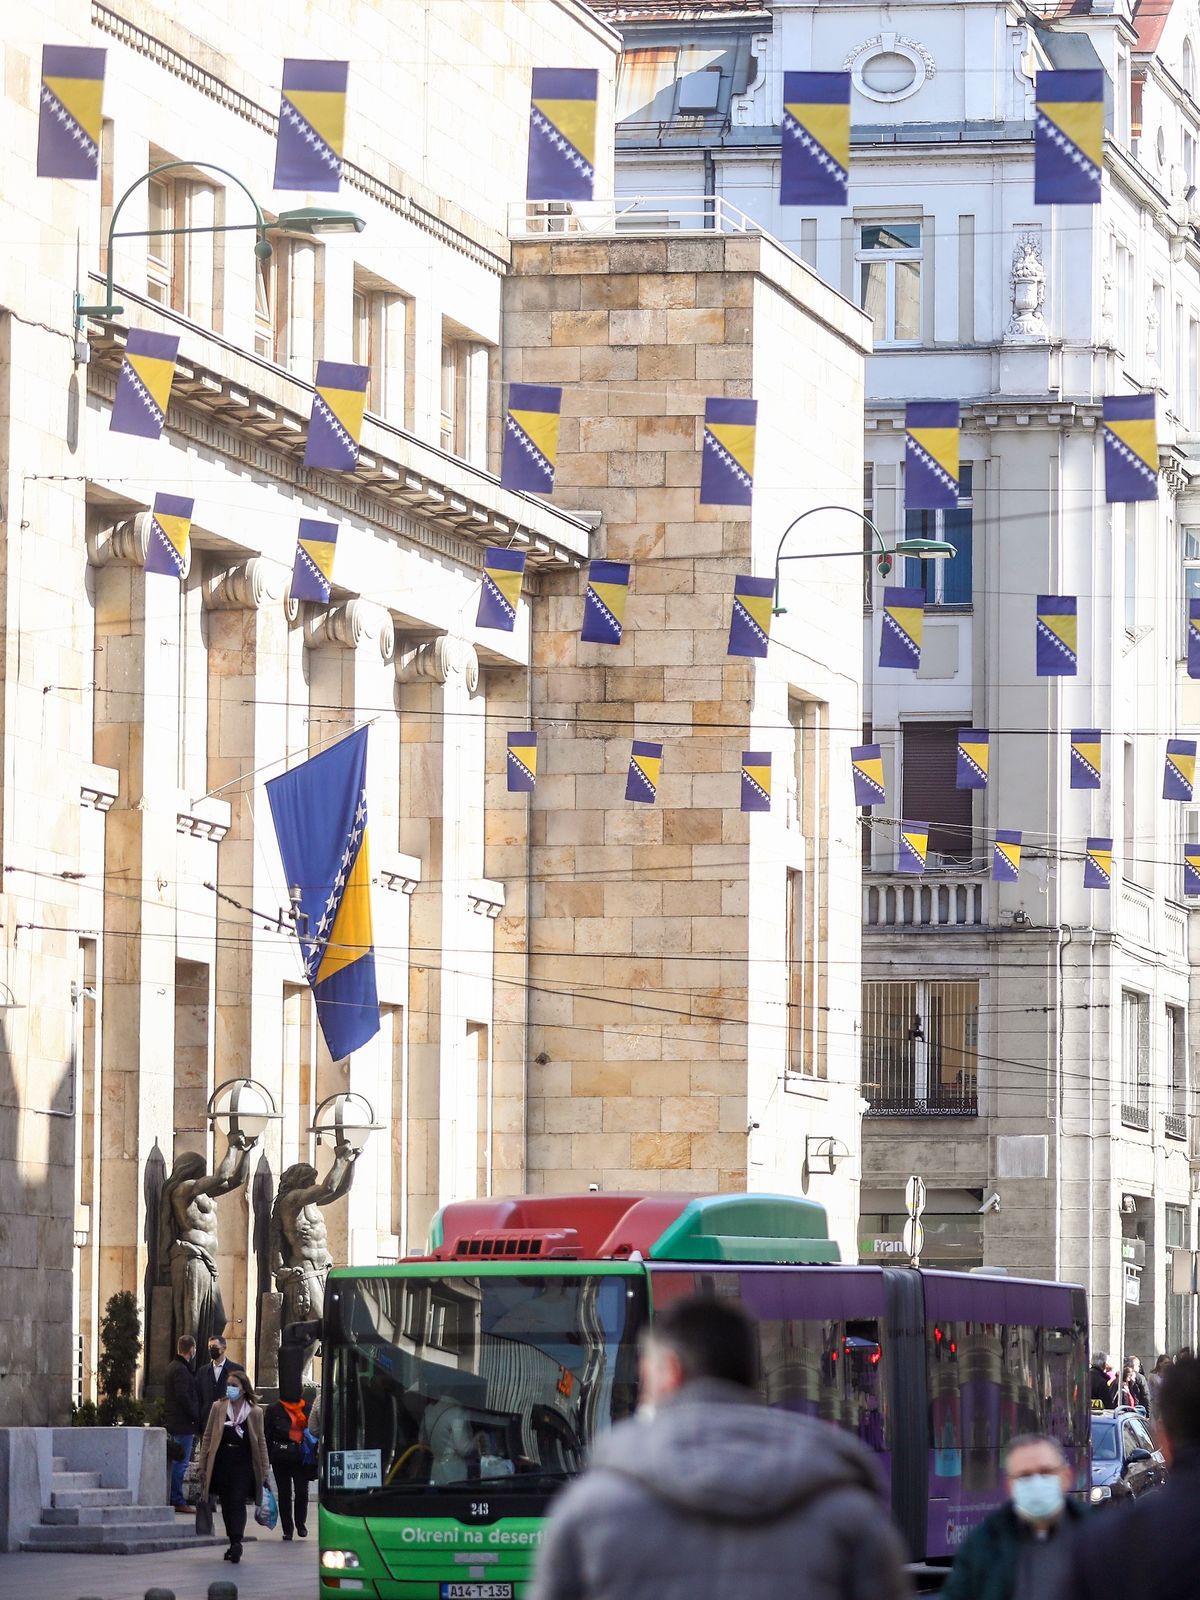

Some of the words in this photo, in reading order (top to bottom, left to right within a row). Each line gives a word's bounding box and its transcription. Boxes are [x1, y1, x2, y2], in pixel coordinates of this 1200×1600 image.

[873, 1239, 906, 1252] Fran
[471, 1502, 489, 1515] 243
[401, 1527, 459, 1543] Okreni
[463, 1532, 484, 1543] na
[450, 1585, 511, 1598] A14-T-135
